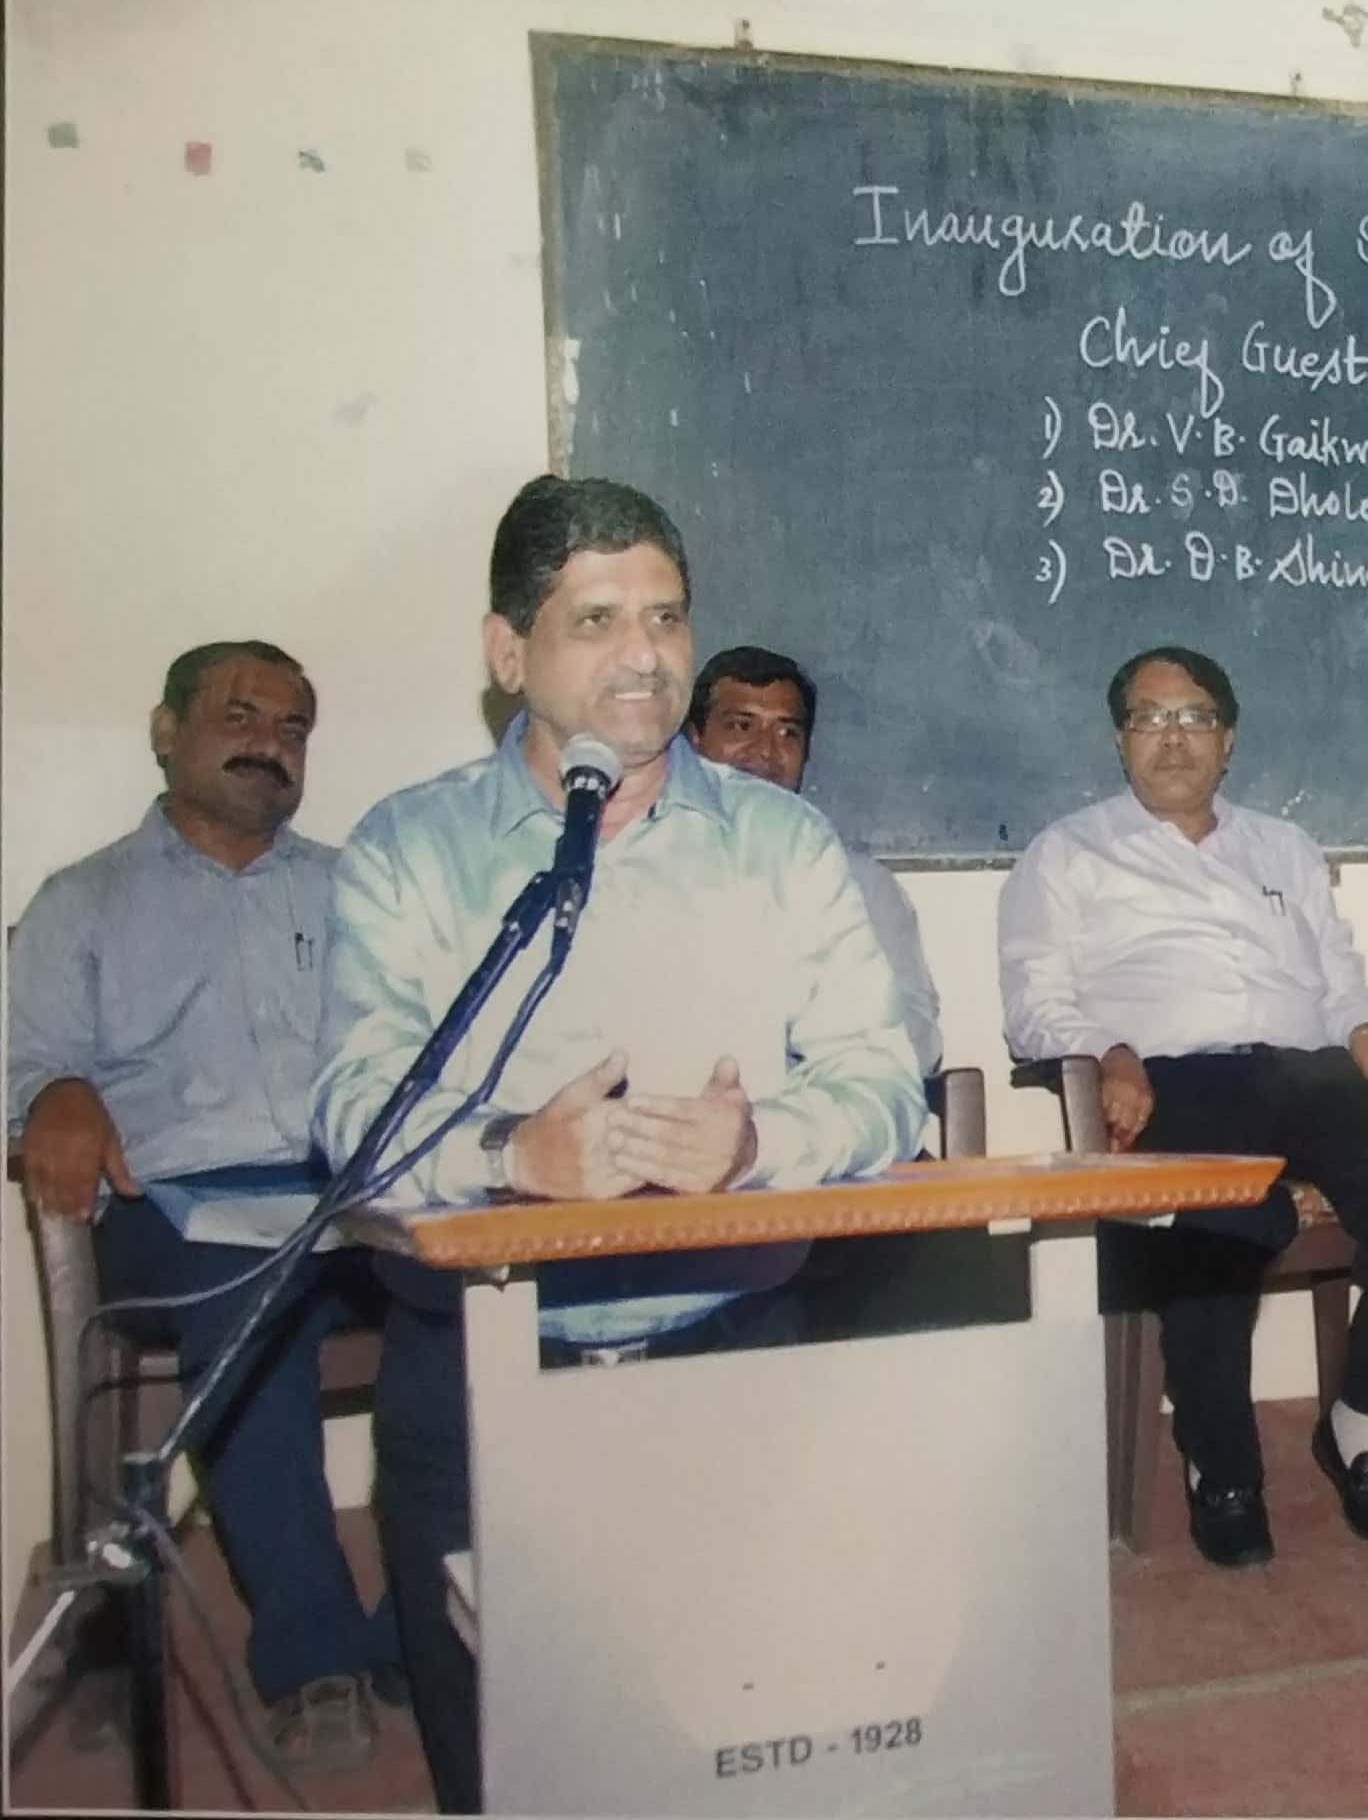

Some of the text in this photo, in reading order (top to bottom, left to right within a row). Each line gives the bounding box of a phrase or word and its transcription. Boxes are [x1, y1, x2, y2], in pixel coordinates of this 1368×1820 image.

[853, 186, 1251, 296] Inauguration
[1268, 230, 1338, 328] of
[1080, 306, 1225, 420] Chief
[1043, 396, 1062, 459] 1)
[1038, 469, 1065, 528] 2)
[1035, 539, 1067, 605] 3)
[715, 1734, 813, 1779] ESTD
[851, 1716, 922, 1754] 1928
